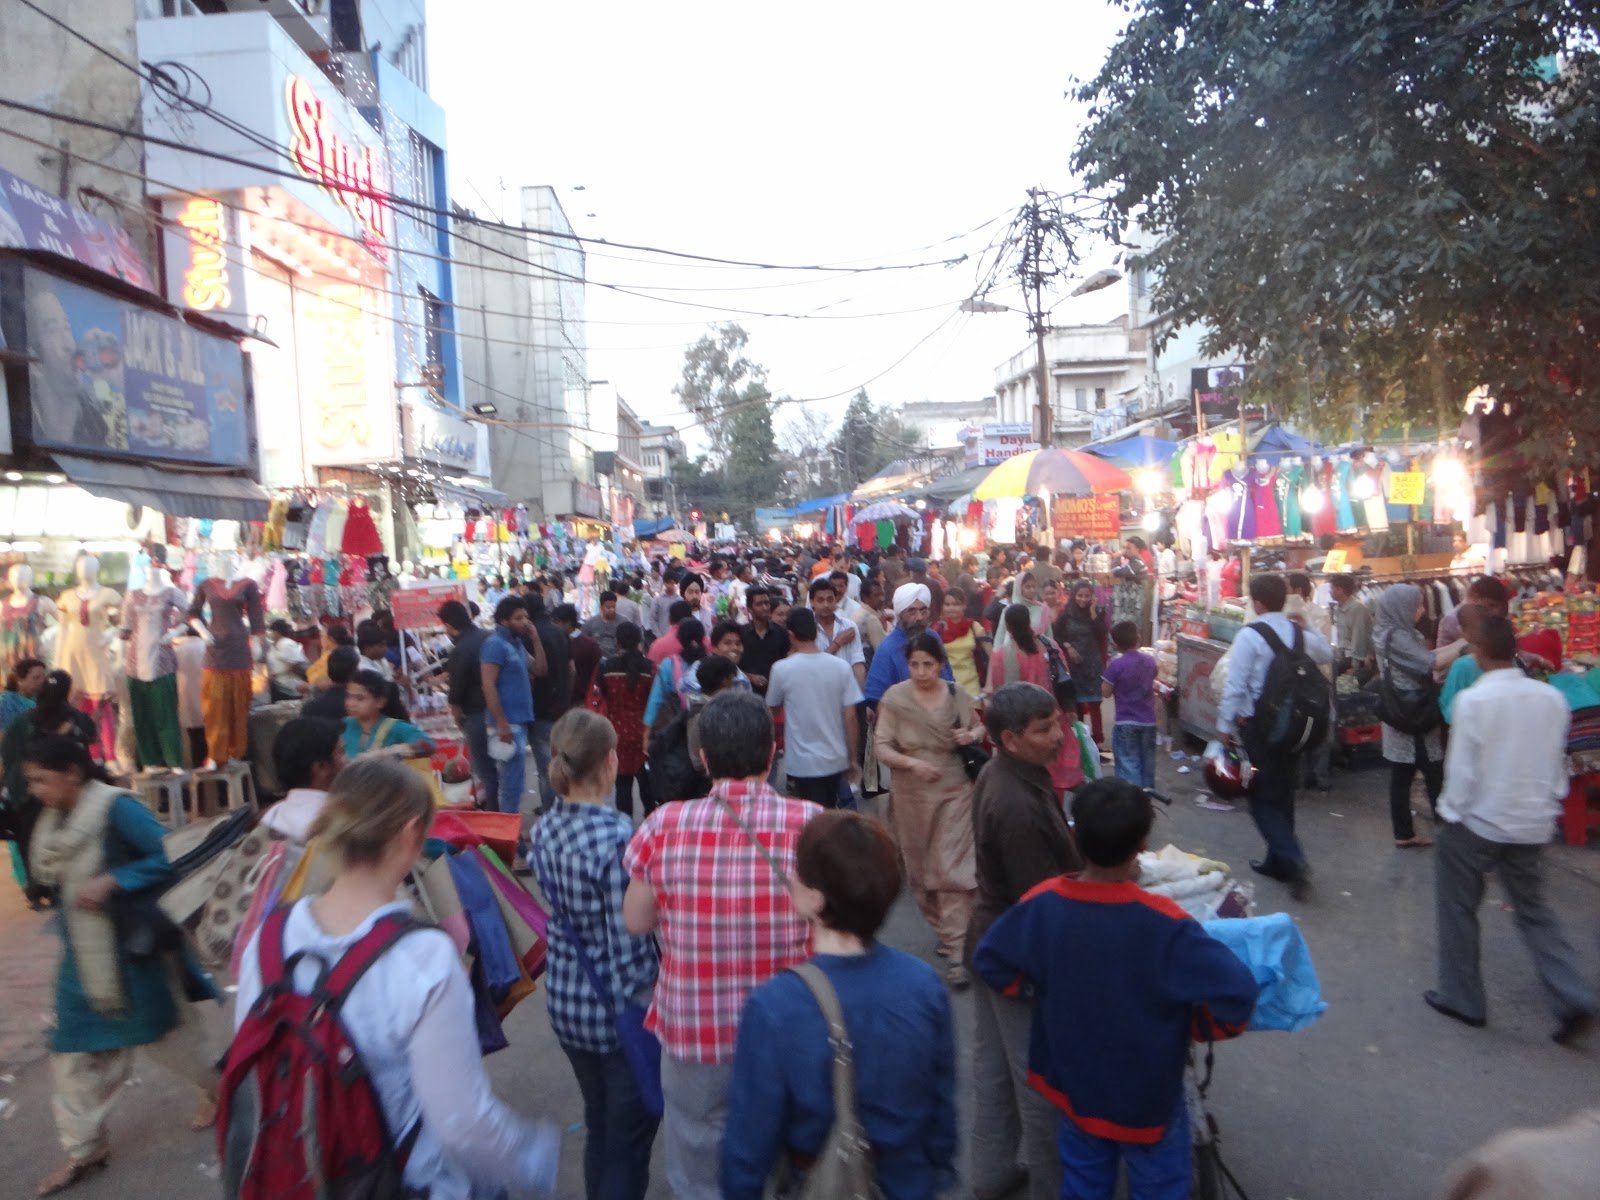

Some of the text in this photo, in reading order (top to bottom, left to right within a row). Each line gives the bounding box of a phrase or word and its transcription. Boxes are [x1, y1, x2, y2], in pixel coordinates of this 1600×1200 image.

[10, 177, 67, 219] JACK
[38, 231, 75, 260] JILL
[178, 198, 231, 311] Stush
[985, 447, 1034, 458] Handl
[1000, 435, 1033, 446] Daya
